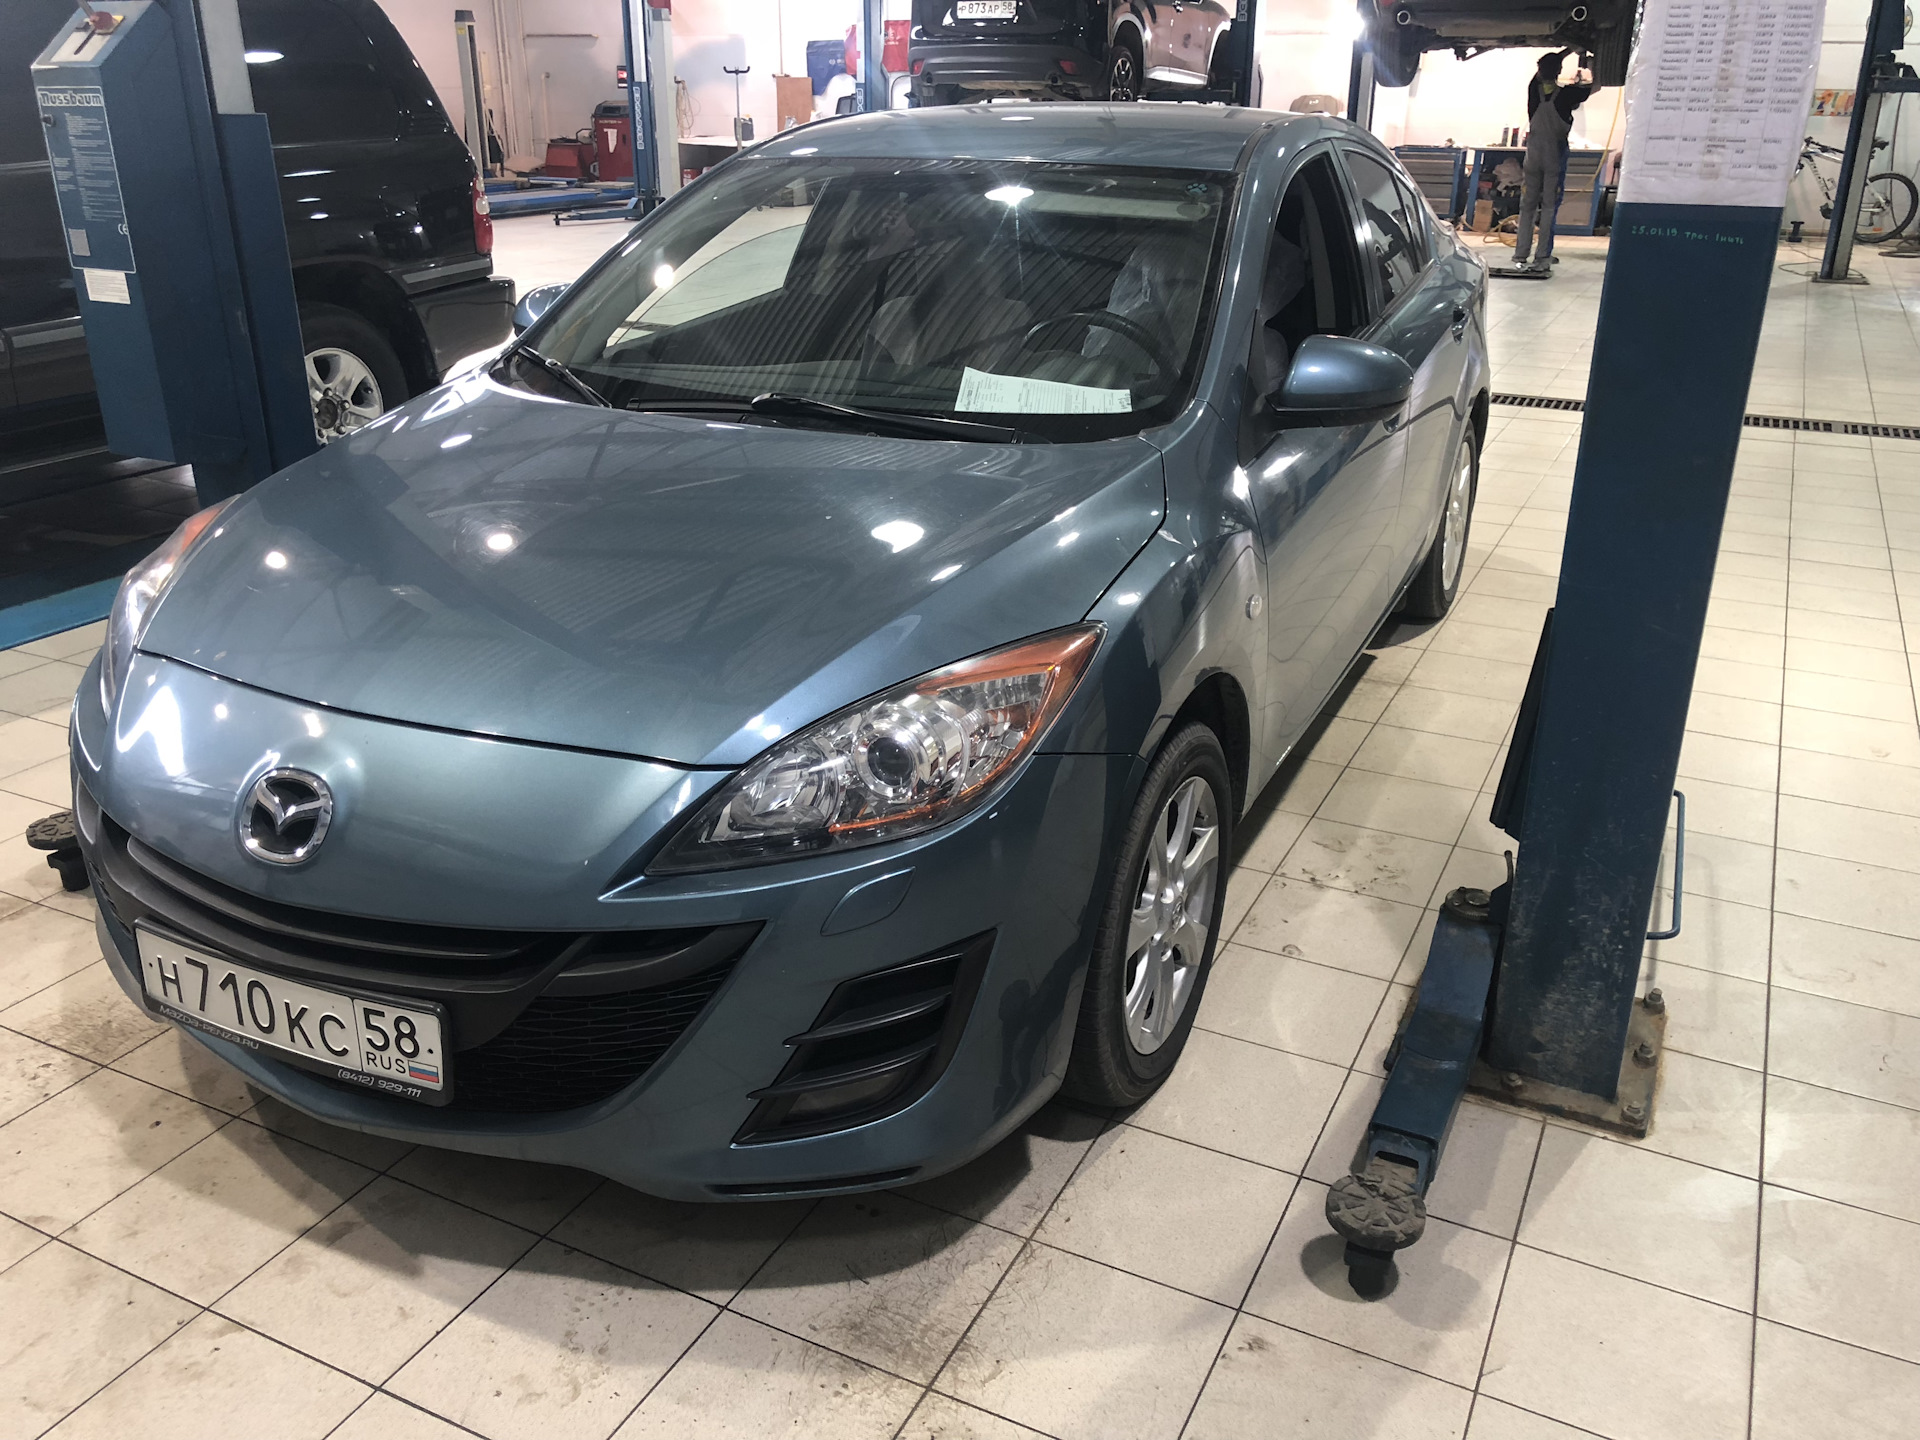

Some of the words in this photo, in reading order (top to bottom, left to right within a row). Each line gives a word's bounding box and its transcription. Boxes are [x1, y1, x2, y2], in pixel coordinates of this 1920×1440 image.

[363, 1007, 420, 1059] 58
[366, 1051, 406, 1074] RUS
[337, 1068, 375, 1086] (8412)
[377, 1079, 422, 1098] 929-111
